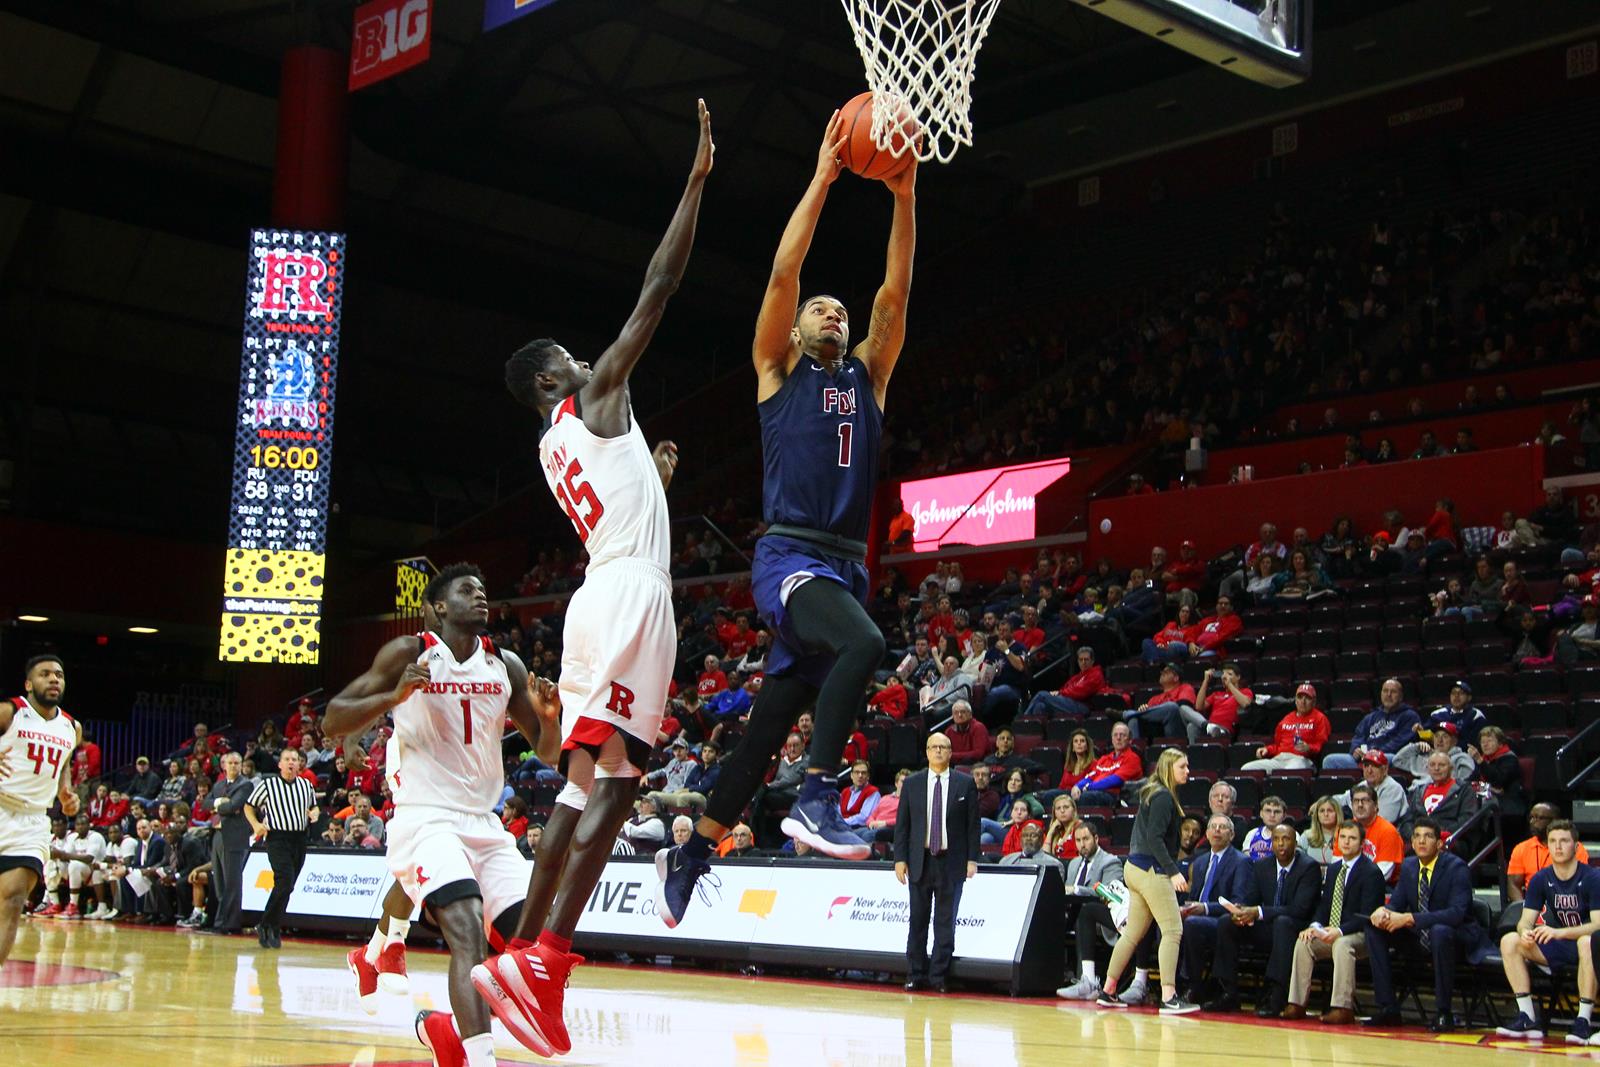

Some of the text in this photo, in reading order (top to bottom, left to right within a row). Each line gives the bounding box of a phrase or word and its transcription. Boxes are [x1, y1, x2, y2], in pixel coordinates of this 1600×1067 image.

[255, 232, 338, 247] PL PT R A F
[328, 251, 337, 262] 0
[328, 266, 336, 277] 0
[247, 337, 330, 352] PL PT R A F
[251, 353, 257, 364] 1
[249, 368, 256, 379] 2
[318, 401, 327, 413] 0
[838, 422, 852, 467] 1
[251, 445, 318, 470] 16:00
[248, 467, 319, 482] RU FDU
[245, 480, 313, 502] 58 2ND 31
[269, 541, 282, 549] FT
[423, 682, 502, 695] RUTGERS
[606, 681, 634, 720] R
[460, 699, 472, 744] 1
[17, 730, 71, 750] RUTGERS
[27, 742, 62, 779] 44
[853, 897, 909, 912] New Jersey
[1555, 894, 1578, 909] FDU
[850, 909, 985, 927] Motor Vehic ssion
